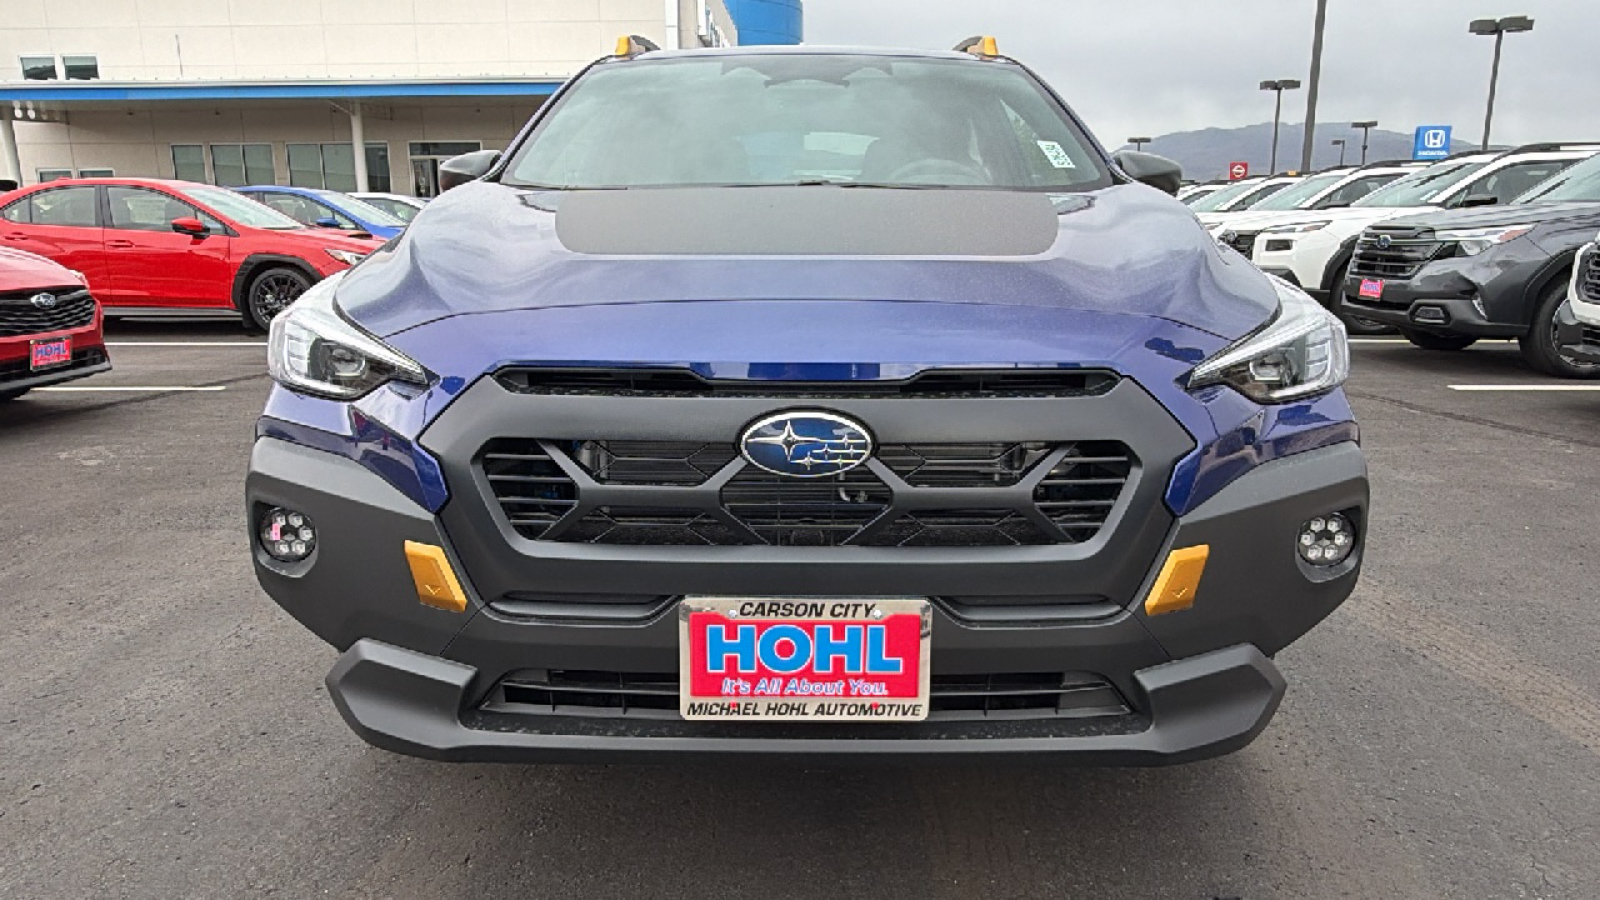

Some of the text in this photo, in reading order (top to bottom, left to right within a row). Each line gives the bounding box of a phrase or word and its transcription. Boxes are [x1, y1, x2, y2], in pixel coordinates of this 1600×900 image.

[739, 602, 876, 618] CARSON CITY
[706, 624, 903, 674] HOHL
[721, 677, 889, 696] It's All About You.
[687, 702, 923, 718] MICHAEL HOHL AUTOMOTIVE
